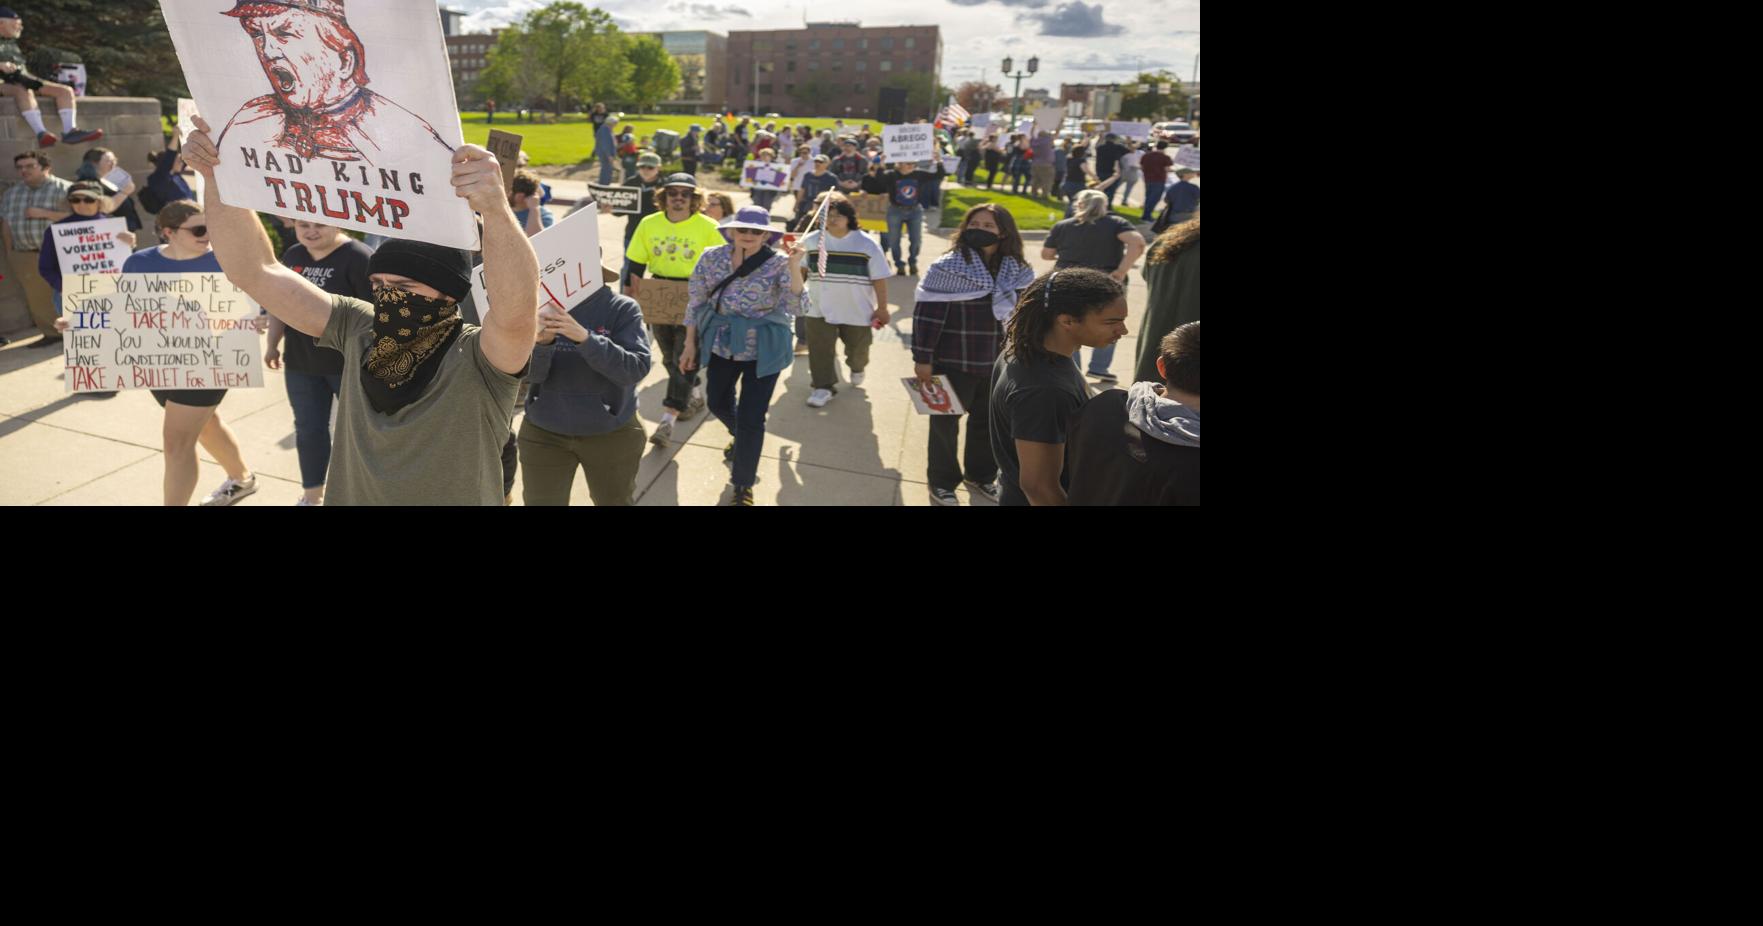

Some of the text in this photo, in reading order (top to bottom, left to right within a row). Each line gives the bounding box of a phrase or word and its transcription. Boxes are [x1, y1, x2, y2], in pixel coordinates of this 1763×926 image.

[240, 146, 424, 195] MAD KING
[264, 176, 410, 230] TRUMP
[58, 226, 95, 237] UNIONS
[78, 232, 111, 243] FIGHT
[62, 241, 114, 254] WORKERS
[80, 252, 105, 262] WIN
[72, 260, 114, 272] POWER
[302, 266, 335, 279] PUBLIC
[76, 273, 98, 294] IF
[111, 275, 137, 293] YOU
[144, 274, 194, 293] WANTED
[201, 274, 221, 293] ME
[65, 293, 236, 314] STAND ASIDE AND LET
[73, 310, 256, 330] ICE TAKE MY STUDENTS
[65, 329, 102, 349] THEN
[114, 328, 142, 351] YOU
[66, 347, 250, 366] HAVE CONDITIONED ME TO
[65, 366, 106, 391] TAKE
[132, 364, 179, 388] BULLET
[186, 369, 205, 388] FOR
[209, 367, 250, 388] THEM
